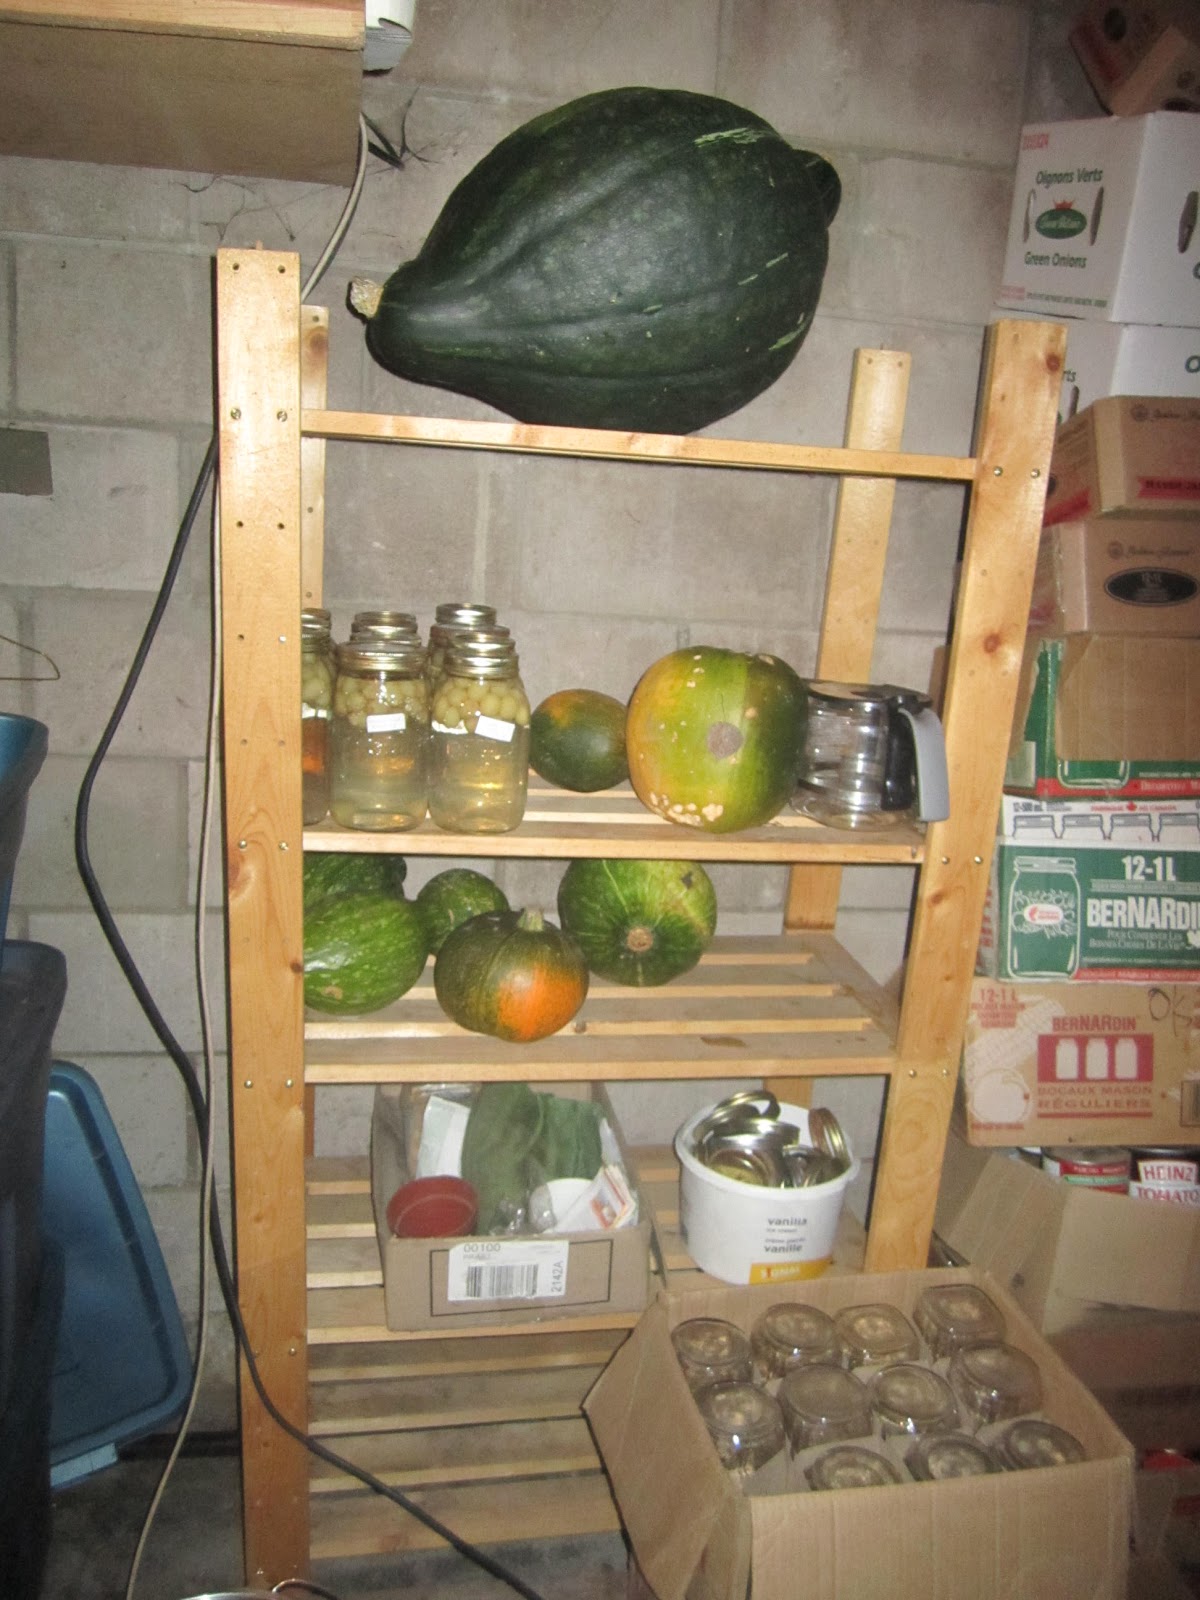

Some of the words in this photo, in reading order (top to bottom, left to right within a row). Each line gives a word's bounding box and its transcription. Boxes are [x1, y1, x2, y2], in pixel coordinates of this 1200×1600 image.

[1036, 170, 1074, 189] Oignons
[1077, 168, 1103, 183] Verts
[1025, 251, 1050, 267] Green
[1052, 253, 1087, 269] Onions
[1052, 1015, 1136, 1031] BERNARDIN
[1038, 1086, 1095, 1096] BOCAUX
[1101, 1086, 1153, 1096] MASON
[1143, 1165, 1194, 1182] HEINZ
[767, 1217, 808, 1227] vanilla
[764, 1244, 803, 1253] vanille
[551, 1260, 564, 1293] 2142A
